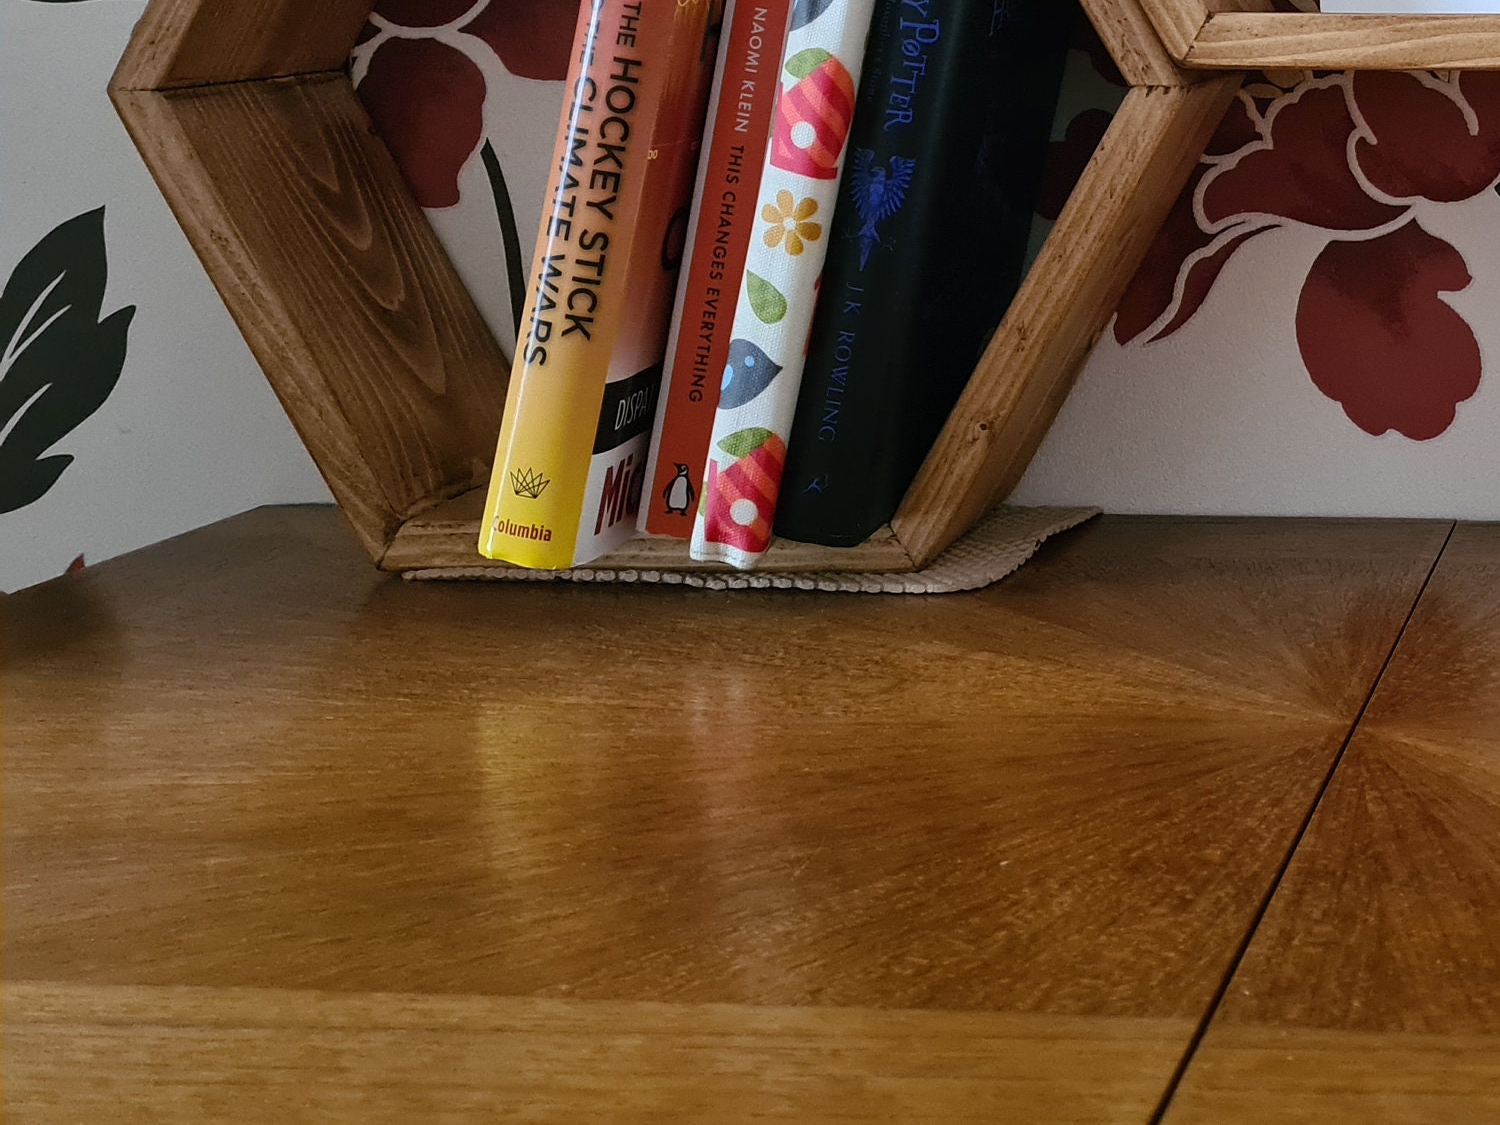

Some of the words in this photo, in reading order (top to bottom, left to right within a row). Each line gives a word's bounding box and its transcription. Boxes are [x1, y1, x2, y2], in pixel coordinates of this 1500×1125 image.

[616, 1, 642, 48] THE
[744, 7, 768, 74] NAOMI
[883, 18, 942, 132] POTTER
[546, 76, 597, 242] CLIMATE
[586, 56, 643, 221] HOCKEY
[734, 79, 756, 134] KLEIN
[726, 145, 745, 184] THIS
[561, 228, 610, 341] STICK
[709, 190, 736, 281] CHANGES
[523, 254, 566, 367] WARS
[689, 288, 721, 403] EVERYTHING
[818, 330, 856, 442] ROWLING
[493, 515, 552, 542] Columbia
